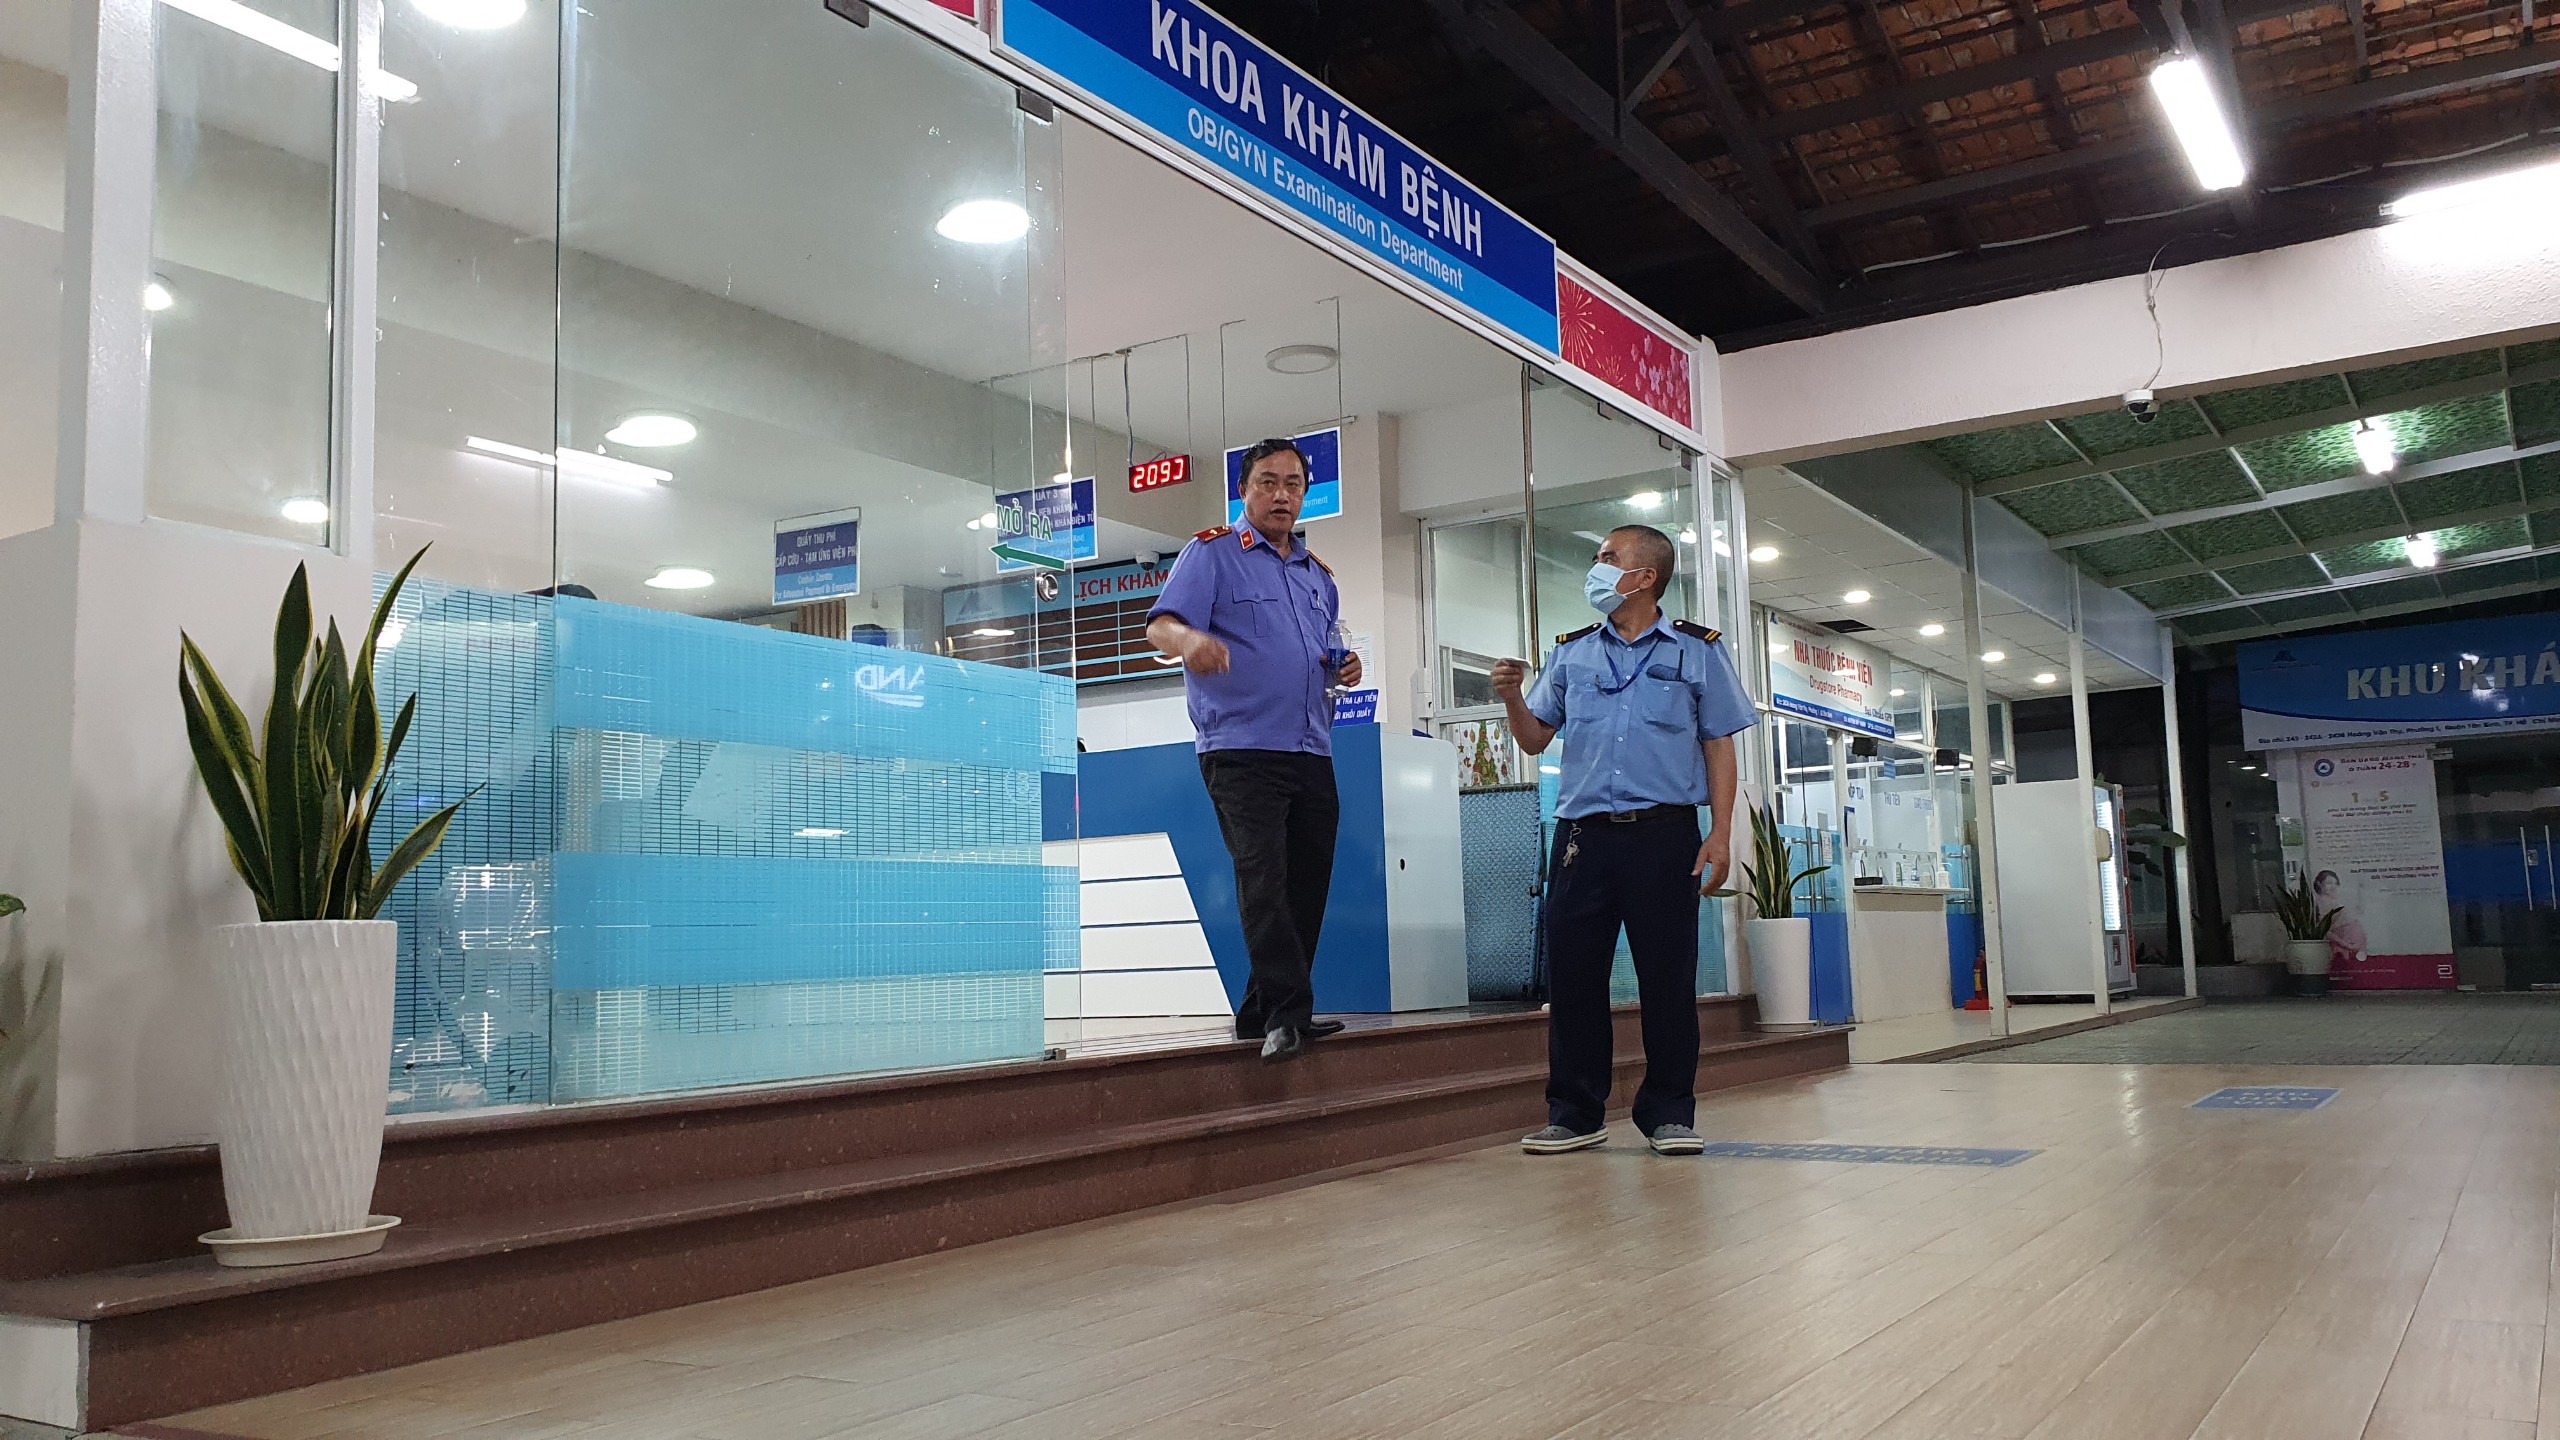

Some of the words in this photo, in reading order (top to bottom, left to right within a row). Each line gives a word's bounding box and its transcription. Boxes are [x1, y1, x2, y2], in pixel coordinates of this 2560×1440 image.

[1151, 0, 1266, 124] KHOA
[1283, 83, 1386, 199] KHÁM
[1401, 161, 1482, 258] BỆNH
[1187, 107, 1267, 178] OB/GYN
[1273, 156, 1376, 241] Examination
[1380, 220, 1464, 291] Department
[995, 497, 1024, 535] MỞ
[1028, 512, 1053, 542] RA
[1303, 496, 1328, 508] ayment
[1794, 638, 1810, 665] NHÀ
[1811, 644, 1836, 672] THUỐC
[1856, 659, 1873, 688] VIỆN
[2347, 662, 2446, 700] KHU
[1809, 675, 1837, 695] Drugstore
[1837, 684, 1863, 706] Pharmacy
[2379, 760, 2410, 770] 24-28
[2379, 790, 2389, 802] 5
